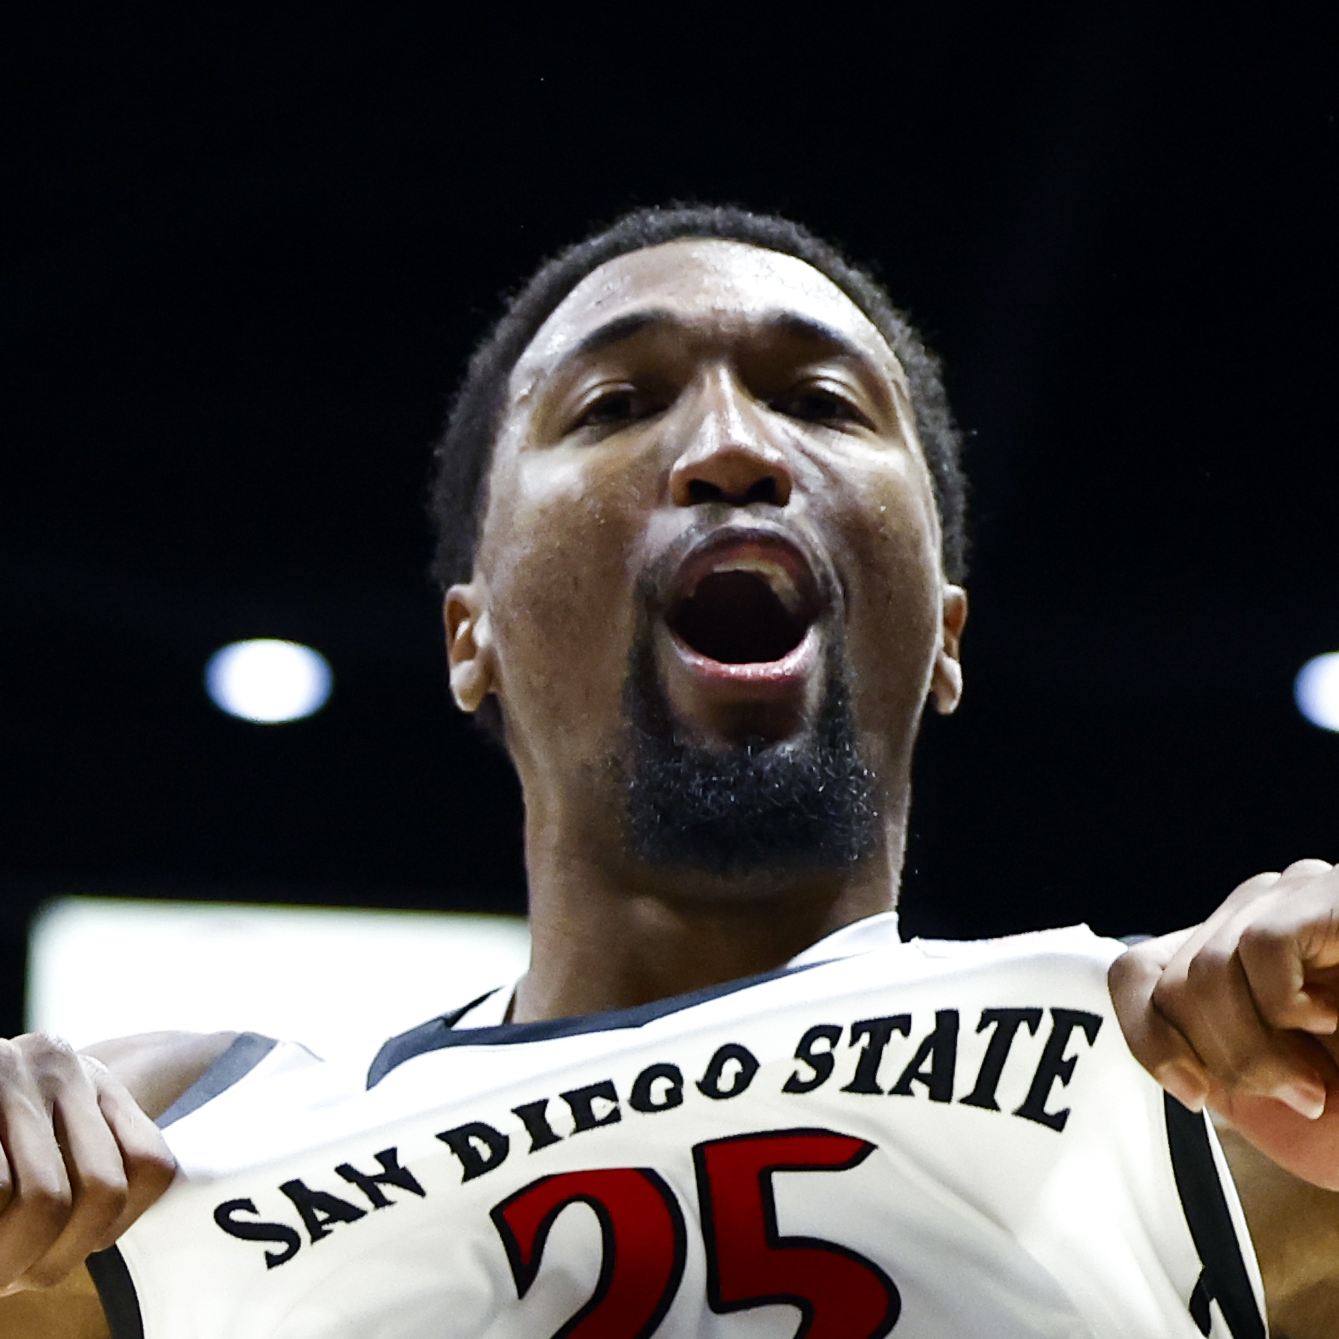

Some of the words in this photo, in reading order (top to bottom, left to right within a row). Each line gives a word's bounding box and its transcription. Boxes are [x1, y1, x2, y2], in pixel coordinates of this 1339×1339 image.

[212, 1146, 427, 1271] SAN
[434, 1042, 762, 1185] DIEGO
[780, 1006, 1105, 1134] STATE
